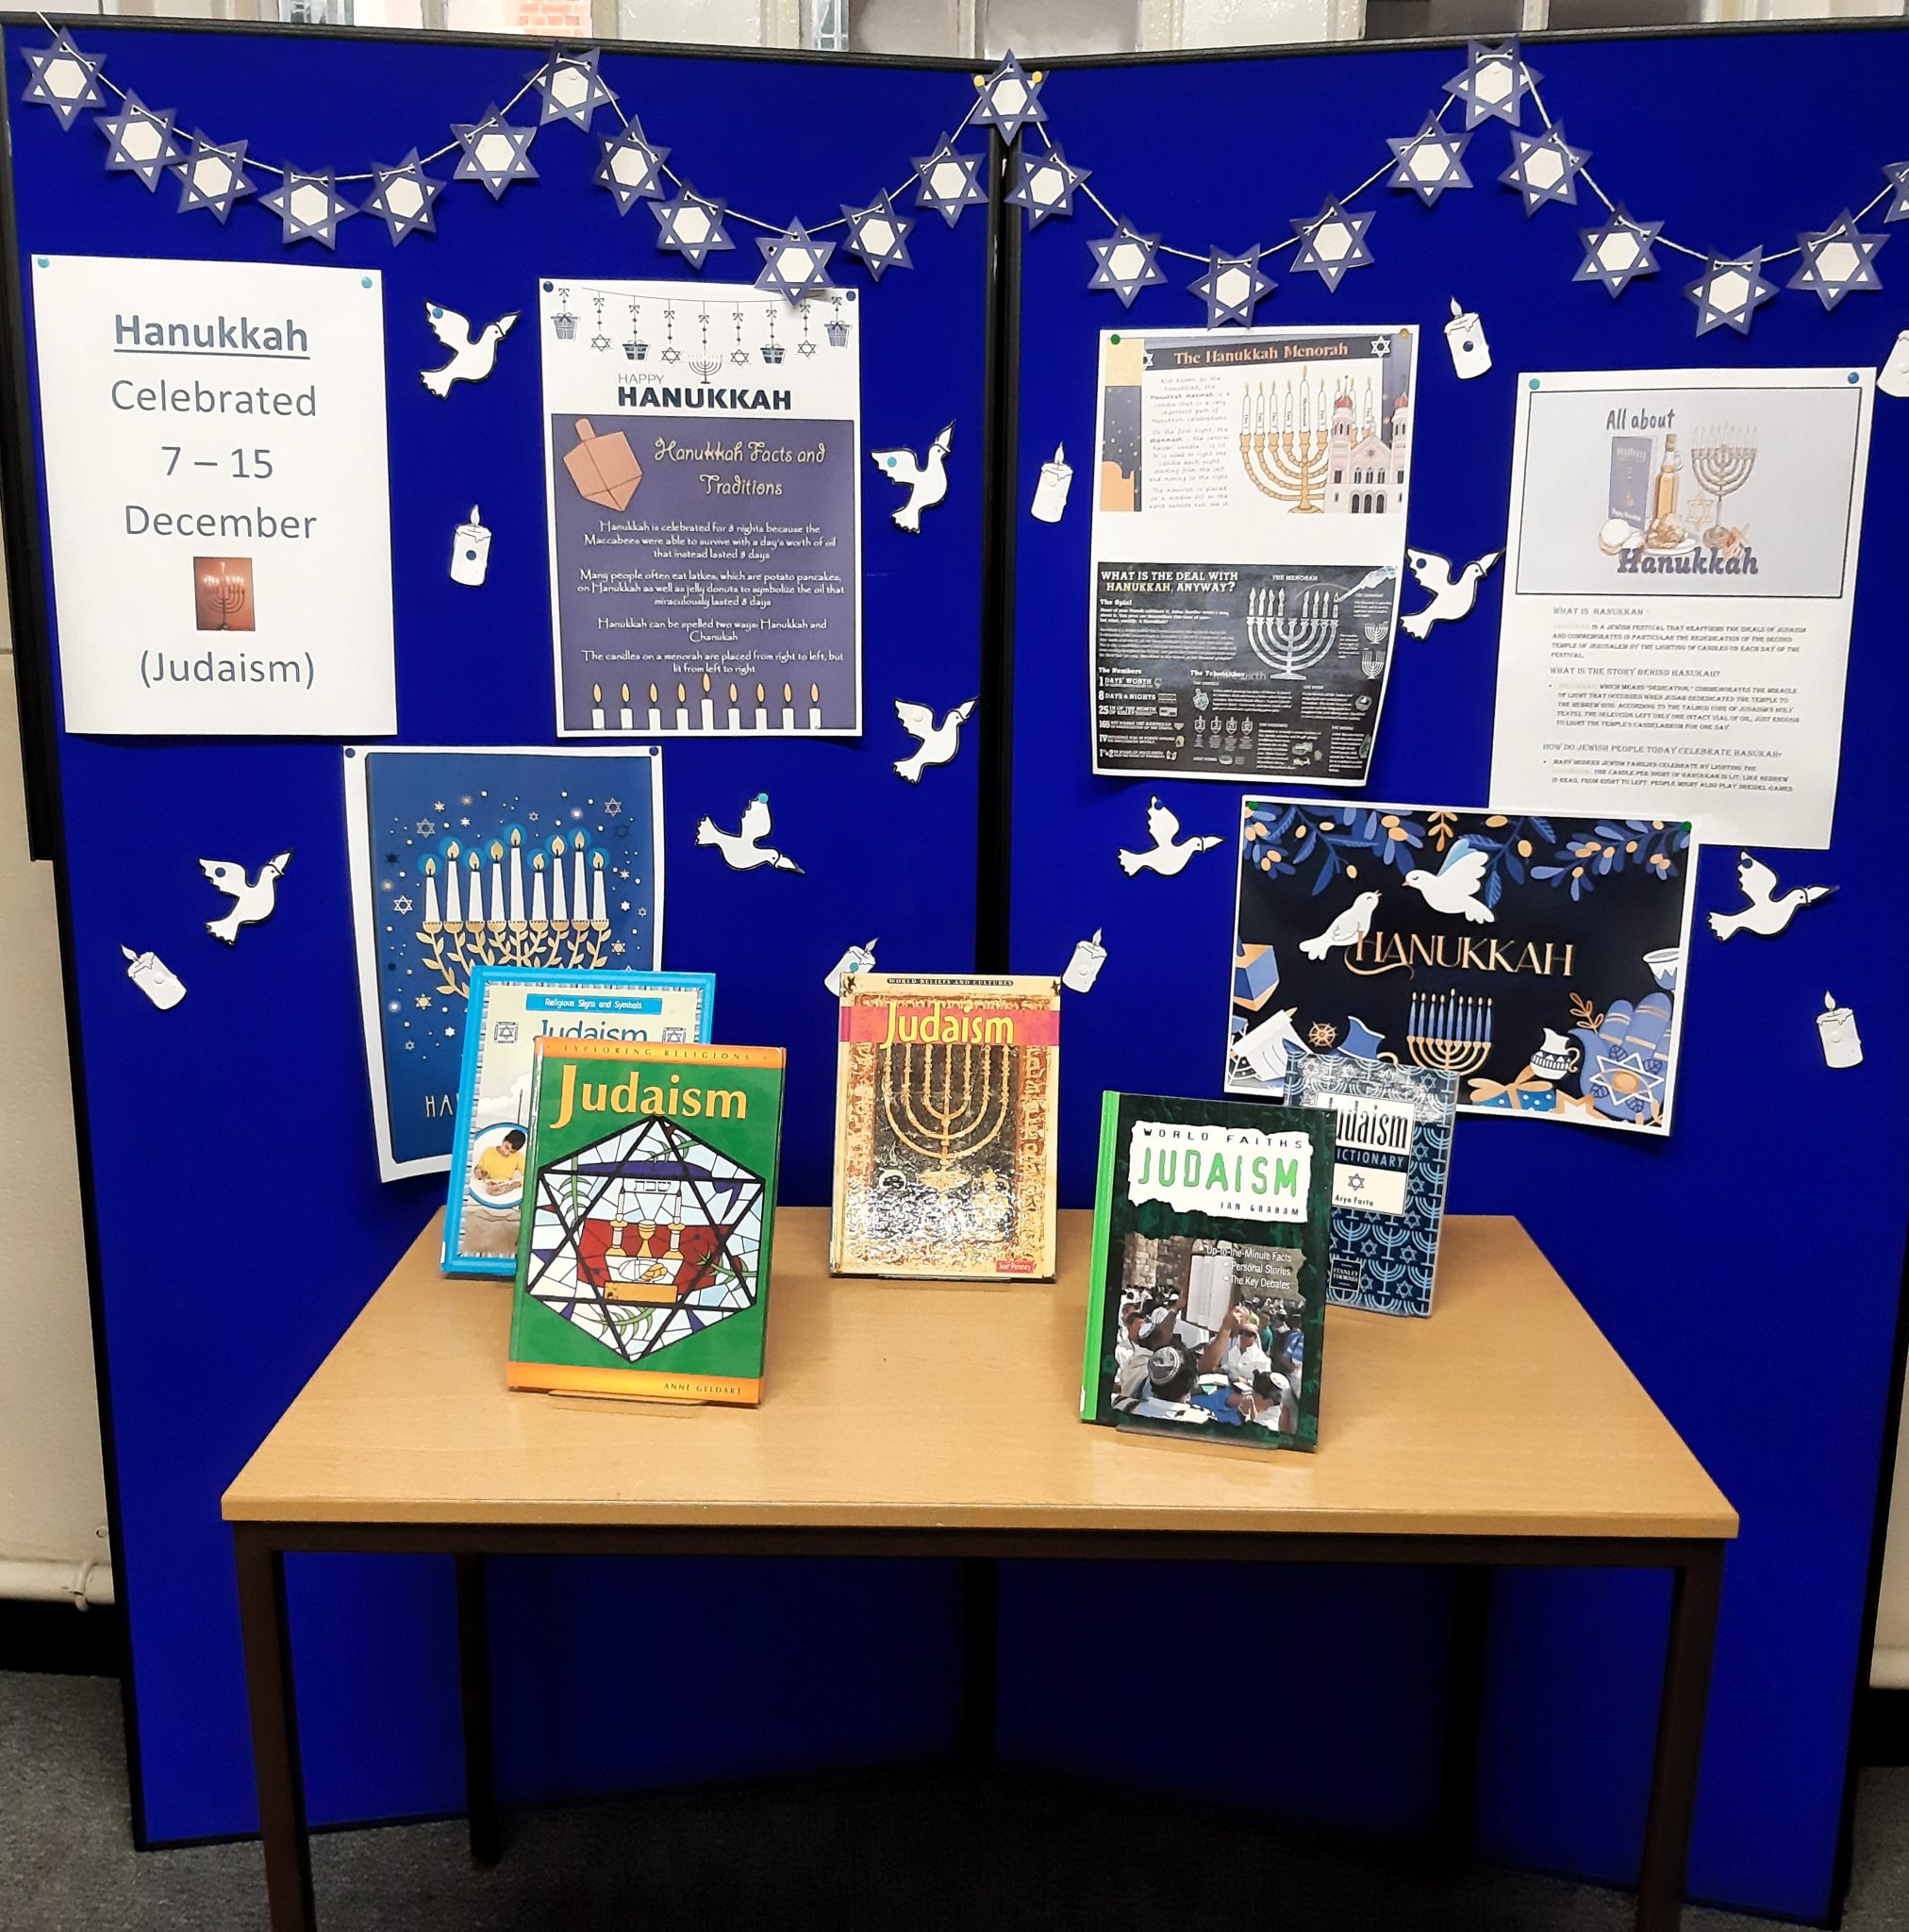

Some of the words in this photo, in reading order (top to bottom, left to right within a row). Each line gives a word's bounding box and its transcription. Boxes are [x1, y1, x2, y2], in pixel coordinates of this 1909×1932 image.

[115, 314, 308, 352] Hanukkah
[1173, 351, 1202, 366] The
[1205, 348, 1278, 364] Hanukkah
[1284, 342, 1348, 358] Menorah
[618, 373, 664, 385] HAPPY
[111, 379, 317, 417] Celebrated
[618, 387, 791, 410] HANUKKAH
[1606, 408, 1626, 430] All
[1631, 408, 1675, 429] about
[654, 437, 743, 462] Hanukkah
[747, 441, 793, 463] Facts
[797, 443, 825, 463] and
[161, 446, 181, 476] 7
[231, 449, 273, 479] 15
[699, 474, 783, 495] Traditions
[125, 506, 317, 540] December
[599, 520, 650, 532] Hanukkah
[652, 522, 659, 531] is
[661, 521, 710, 532] celebrated
[712, 522, 726, 532] for
[737, 523, 764, 536] nights
[766, 522, 804, 533] because
[805, 523, 821, 534] the
[584, 534, 640, 545] Maccabees
[666, 535, 685, 545] able
[687, 536, 698, 545] to
[699, 537, 730, 545] survive
[732, 535, 751, 546] with
[760, 536, 785, 550] day's
[786, 536, 811, 546] worth
[813, 537, 823, 546] of
[824, 537, 837, 547] oil
[1617, 546, 1759, 575] Hanukkah
[580, 569, 608, 581] Many
[610, 569, 643, 583] people
[644, 569, 670, 580] often
[672, 571, 687, 580] eat
[720, 570, 745, 581] which
[764, 574, 795, 585] potato
[1101, 571, 1135, 581] WHAT
[1137, 571, 1149, 581] IS
[1152, 571, 1173, 581] THE
[1175, 571, 1205, 581] DEAL
[1208, 571, 1238, 581] WITH
[1105, 582, 1174, 593] HANUKKAH,
[1176, 581, 1236, 592] ANYWAY?
[597, 618, 648, 629] Hanukkah
[668, 618, 679, 628] be
[681, 618, 714, 632] spelled
[760, 618, 808, 630] Hanukkah
[810, 619, 827, 629] and
[689, 630, 739, 643] Chanukah
[581, 650, 603, 661] The
[606, 650, 640, 660] candles
[664, 651, 703, 660] menorah
[722, 650, 751, 663] placed
[754, 650, 773, 660] from
[775, 650, 796, 663] right
[798, 652, 807, 660] to
[828, 650, 843, 661] but
[140, 650, 316, 690] (Judaism)
[684, 662, 704, 673] from
[706, 662, 721, 673] left
[735, 663, 755, 675] right
[1587, 667, 1604, 675] THE
[1637, 668, 1669, 676] BEHIND
[1098, 691, 1104, 701] 8
[1098, 706, 1109, 716] 25
[1678, 747, 1732, 757] CELEBRATE
[1345, 930, 1575, 978] HANUKKAH
[544, 998, 574, 1009] Religious
[578, 999, 595, 1009] Signs
[599, 1000, 611, 1008] and
[614, 1000, 642, 1010] Symbols
[541, 1020, 647, 1041] Judaism
[879, 1001, 1014, 1050] Judaism
[564, 1044, 652, 1057] EXPLORING
[664, 1049, 751, 1061] RELIGIONS
[549, 1064, 747, 1130] Judaism
[425, 1093, 459, 1118] HA
[1329, 1097, 1408, 1149] udaism
[1143, 1128, 1209, 1141] WORLD
[1227, 1135, 1303, 1149] FAITHS
[1336, 1148, 1404, 1168] ICTIONARY
[1137, 1146, 1299, 1198] JUDAISM
[634, 1180, 672, 1192] שבת
[1335, 1194, 1352, 1205] Arye
[1353, 1197, 1373, 1207] Forta
[1220, 1202, 1240, 1210] IAN
[1250, 1205, 1299, 1216] GRAHAM
[1206, 1244, 1270, 1260] Up-to-the-Minute
[1271, 1251, 1292, 1263] Facts
[1010, 1261, 1032, 1273] Penney
[1231, 1260, 1263, 1274] Personal
[1265, 1264, 1291, 1276] Stories
[1231, 1274, 1244, 1285] The
[1245, 1276, 1259, 1289] Key
[1260, 1278, 1290, 1290] Debates
[664, 1382, 690, 1391] ANNE
